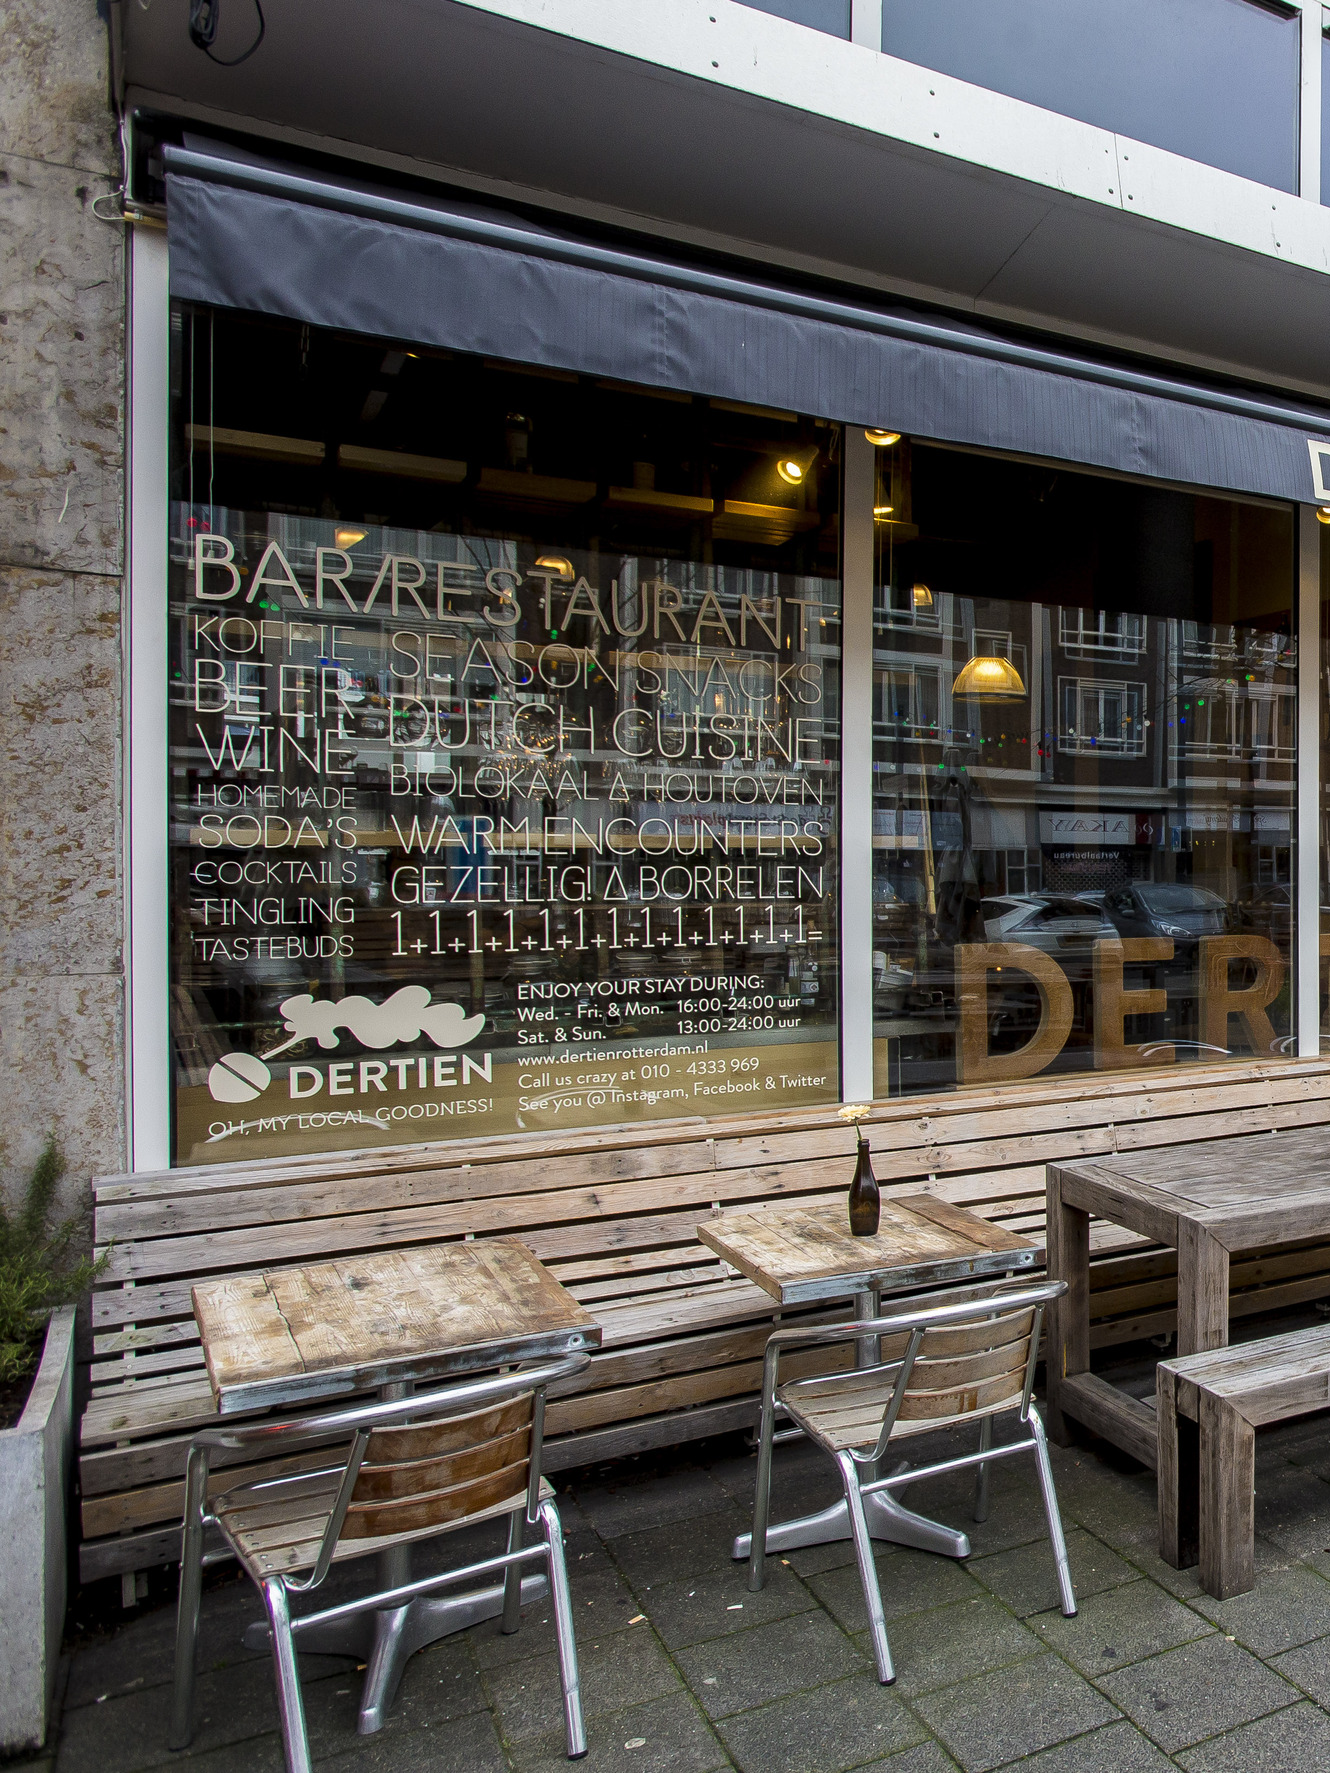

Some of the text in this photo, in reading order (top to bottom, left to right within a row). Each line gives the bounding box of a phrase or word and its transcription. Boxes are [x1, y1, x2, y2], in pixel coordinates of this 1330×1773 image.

[193, 533, 824, 653] BAR/RESTAURANT
[194, 614, 356, 661] KOFFIE
[389, 631, 823, 705] SEASON SNACKS
[194, 658, 356, 720] BEER
[195, 723, 357, 775] WINE
[389, 694, 823, 765] DUTCH CUISINE
[197, 784, 358, 810] HOMEMADE
[390, 763, 599, 801] BIOLOKAAL
[643, 773, 824, 806] HOUTOVEN
[198, 814, 358, 849] SODA'S
[391, 814, 530, 855] WARM
[543, 816, 824, 857] ENCOUNTERS
[193, 860, 358, 885] COCKTAILS
[391, 865, 592, 904] GEZELLIG!
[638, 864, 824, 900] BORRELEN
[194, 896, 355, 926] TINGLING
[194, 934, 355, 962] TASTEBUDS
[517, 974, 765, 1000] ENJOY YOUR STAY DURING:
[517, 1006, 559, 1022] Wed.
[577, 1003, 603, 1019] Fri.
[608, 1002, 621, 1018] &
[625, 1001, 664, 1017] Mon.
[677, 995, 775, 1013] 16:00-24:00
[778, 998, 801, 1009] uur
[517, 1015, 801, 1045] Sat. & Sun. 13:00-24:00 uur
[517, 1039, 709, 1067] www.dertienrotterdam.nl
[289, 1052, 493, 1099] DERTIEN
[517, 1072, 551, 1089] Call
[554, 1074, 573, 1087] us
[576, 1070, 617, 1087] crazy
[620, 1068, 636, 1082] at
[640, 1064, 671, 1080] 010
[686, 1060, 727, 1077] 4333
[730, 1057, 760, 1072] 969
[517, 1073, 827, 1114] See you @ Instagram, Facebook & Twitter
[208, 1098, 494, 1137] OH, MY LOCAL GOODNESS!
